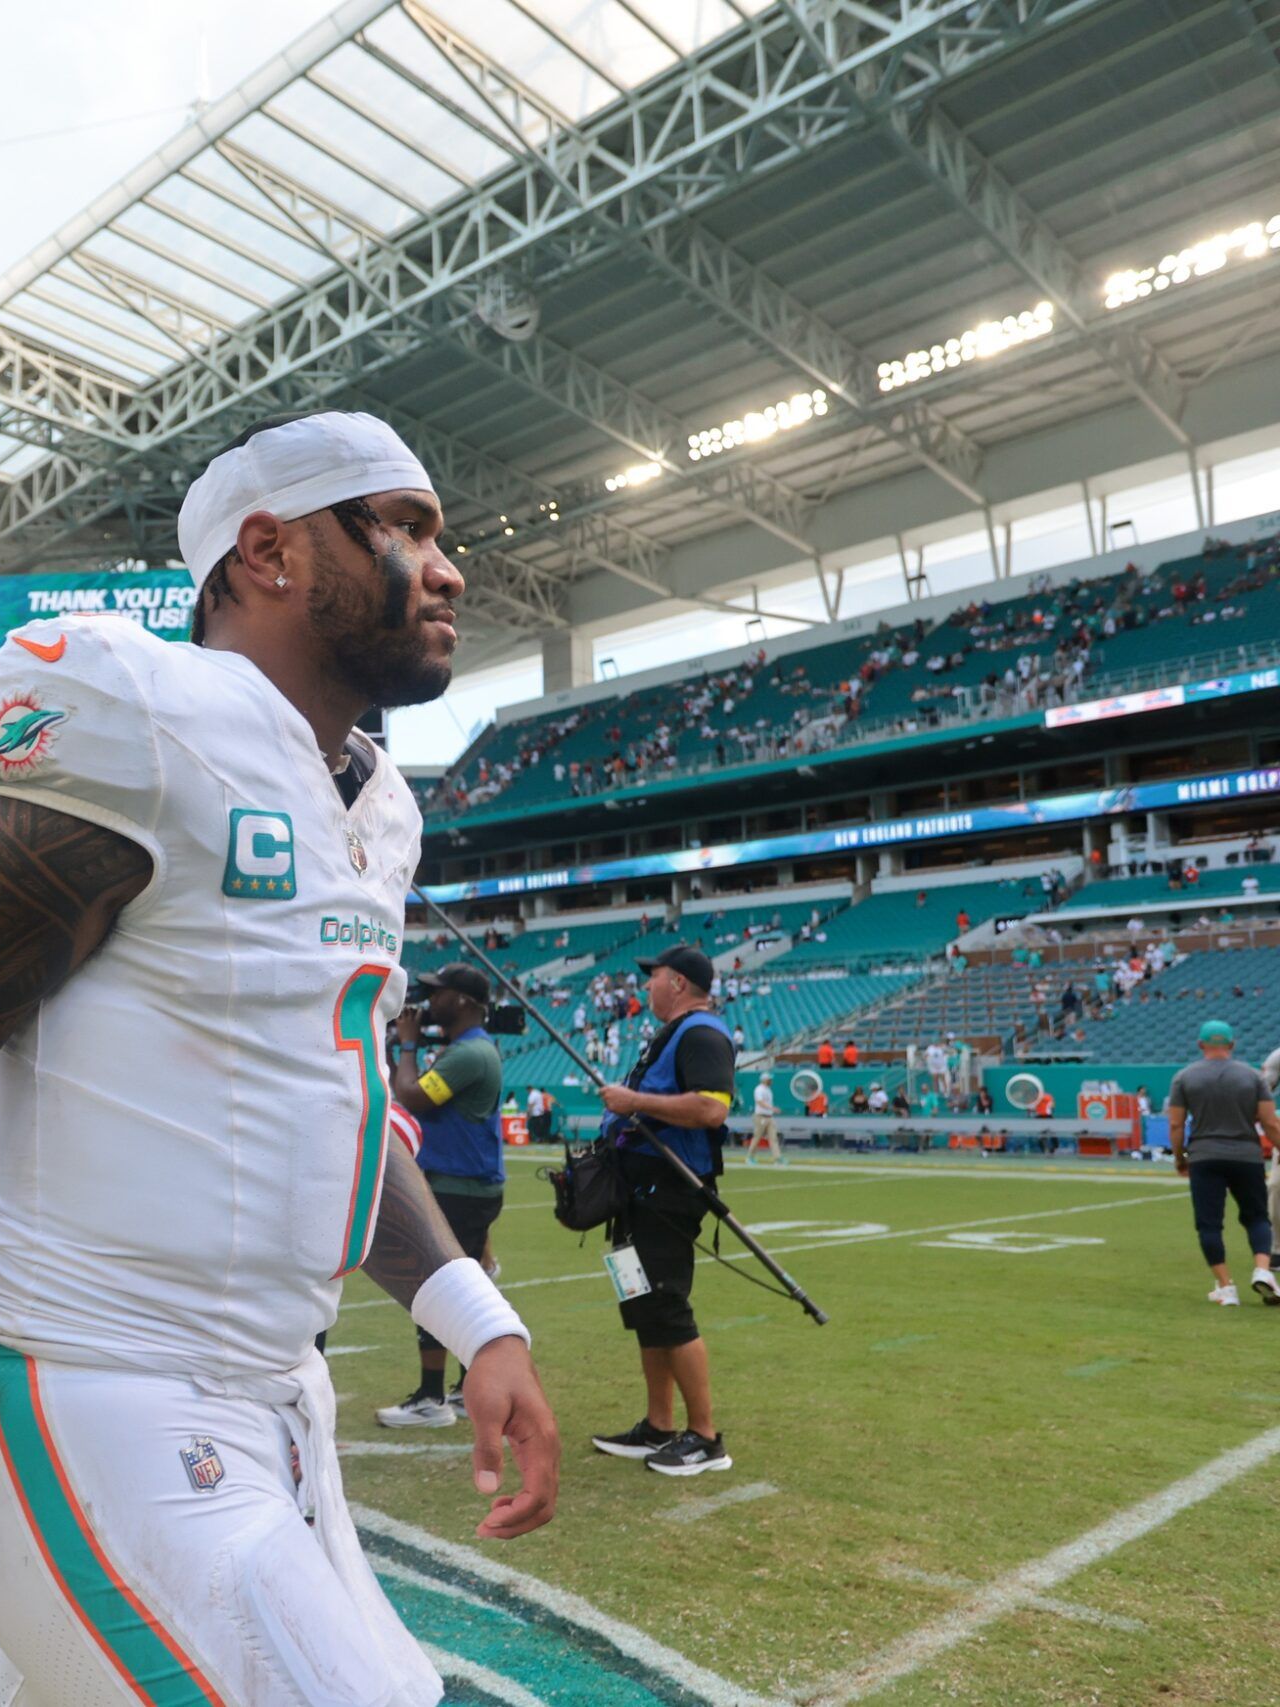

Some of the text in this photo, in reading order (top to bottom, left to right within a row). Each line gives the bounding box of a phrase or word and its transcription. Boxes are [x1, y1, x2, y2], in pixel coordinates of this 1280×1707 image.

[27, 586, 196, 613] THANK YOU FO
[147, 606, 190, 629] US!
[1177, 777, 1230, 801] MIAMI
[834, 813, 973, 847] NEW ENGLAND PATRIOTS
[236, 815, 291, 876] C
[498, 870, 569, 893] MIAMI DOLPHINS
[194, 1459, 221, 1485] NFL
